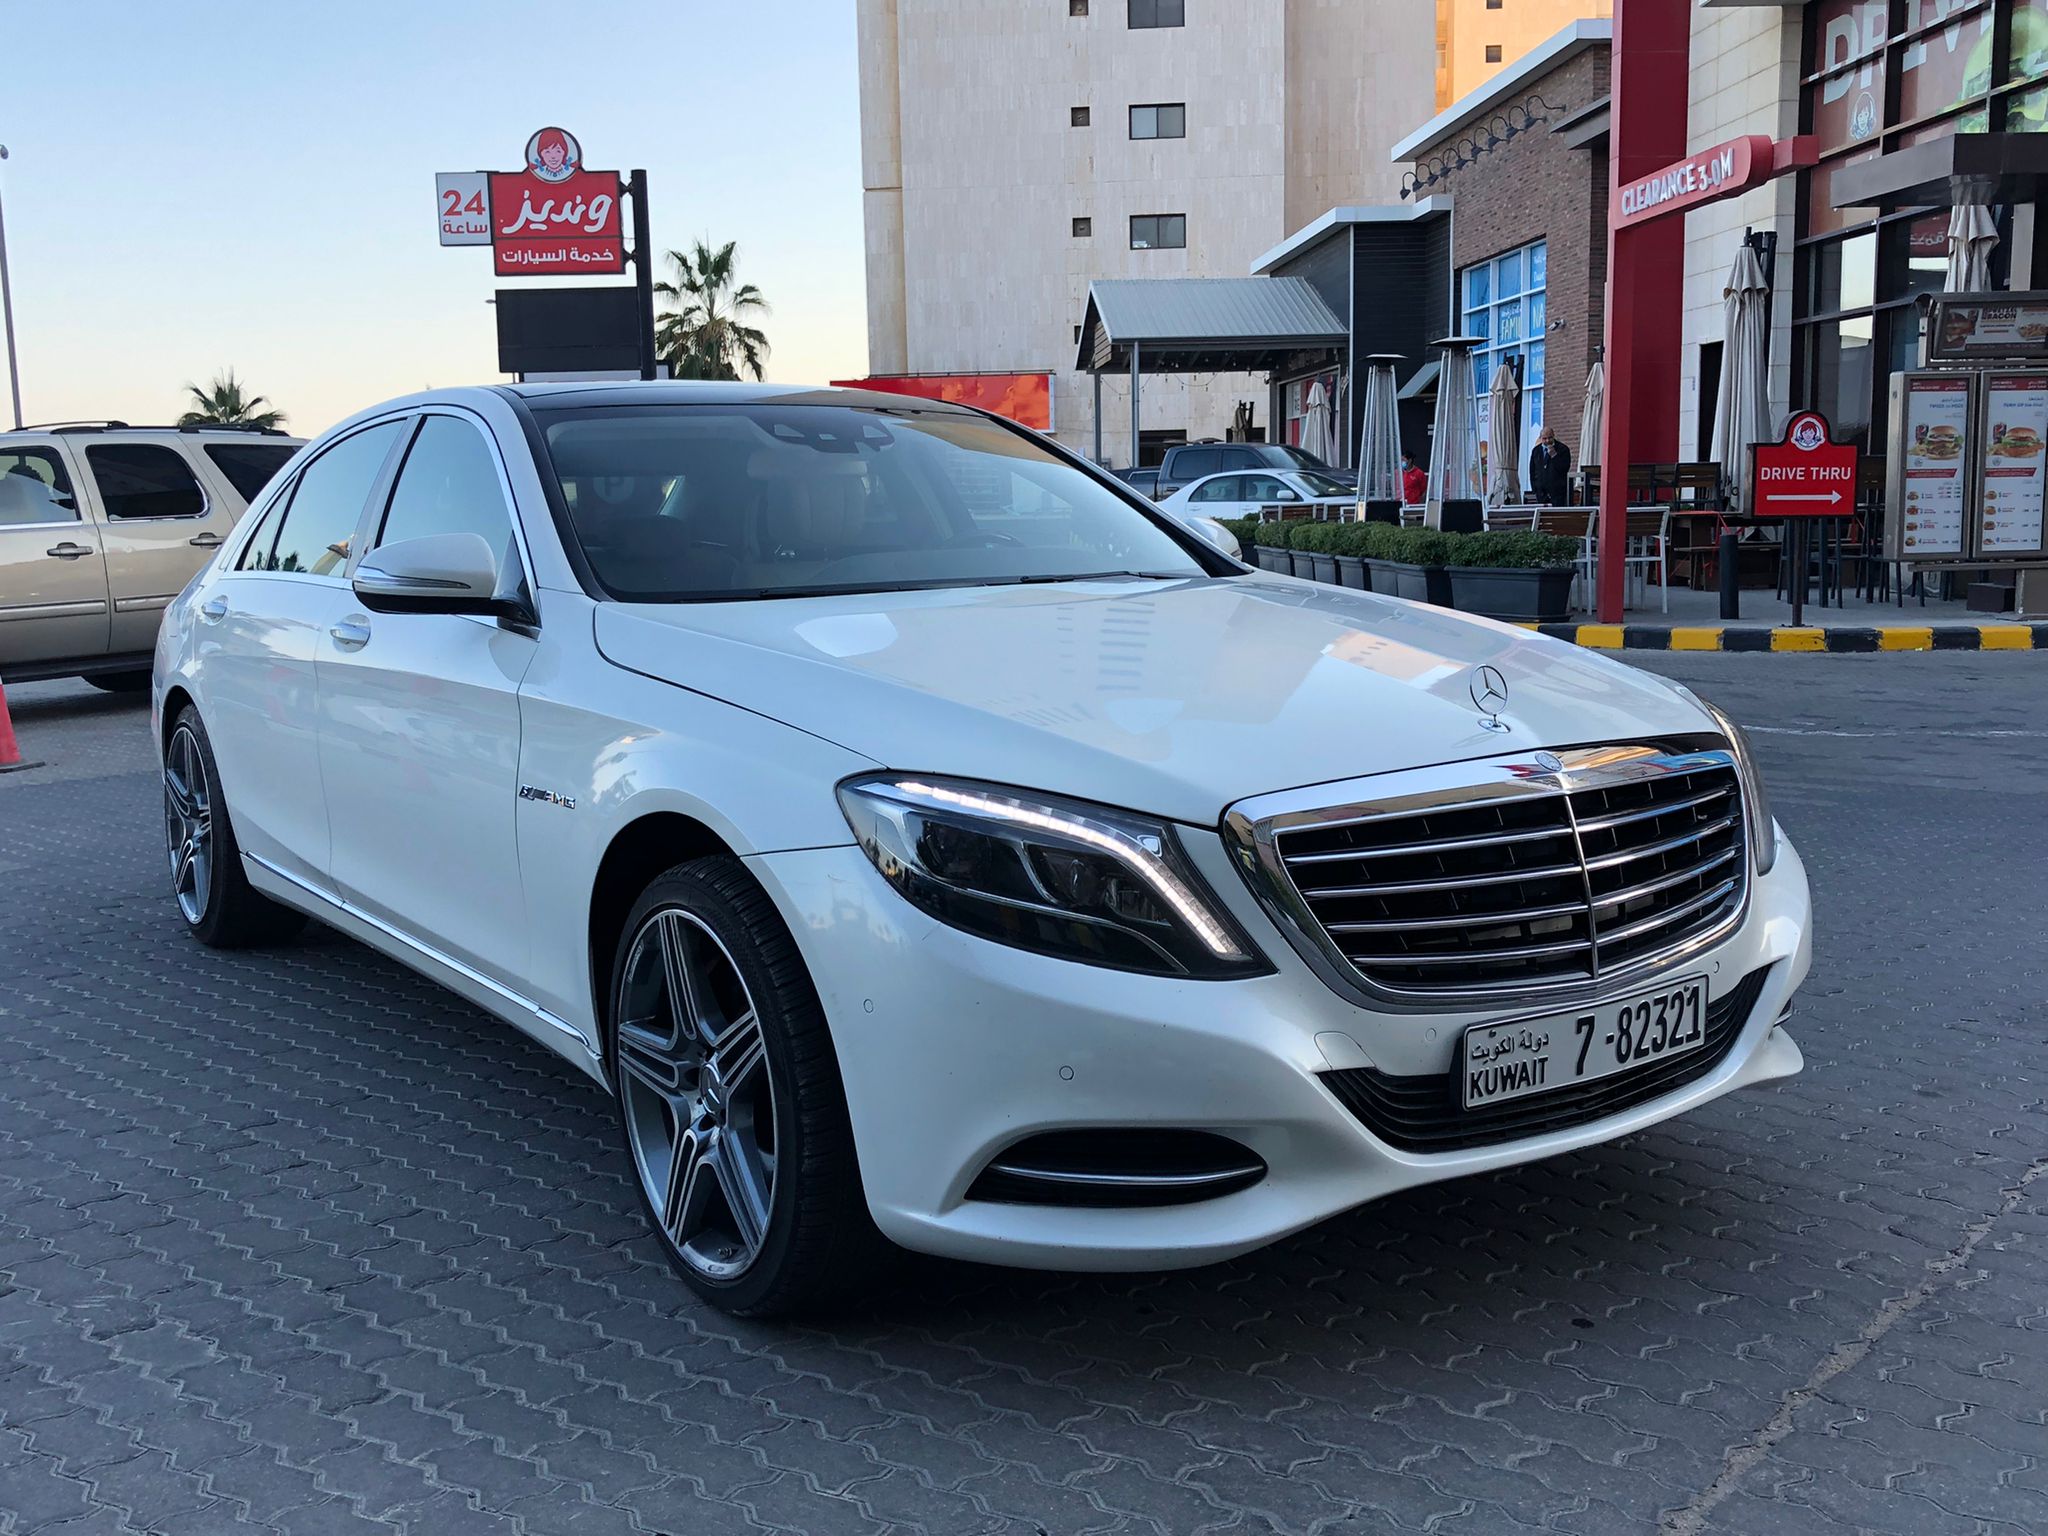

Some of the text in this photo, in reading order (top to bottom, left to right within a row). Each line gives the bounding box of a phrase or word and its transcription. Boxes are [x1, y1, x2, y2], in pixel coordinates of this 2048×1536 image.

[442, 189, 486, 216] 24
[1622, 162, 1697, 216] CLEARANCE
[501, 190, 613, 235] ونديز
[443, 220, 488, 234] ساعة
[502, 247, 614, 265] خدمة السيارات
[1761, 467, 1851, 480] DRIVE THRU
[544, 790, 576, 809] AMG
[1471, 1027, 1549, 1064] دولة الكويت
[1469, 1056, 1549, 1100] KUWAIT
